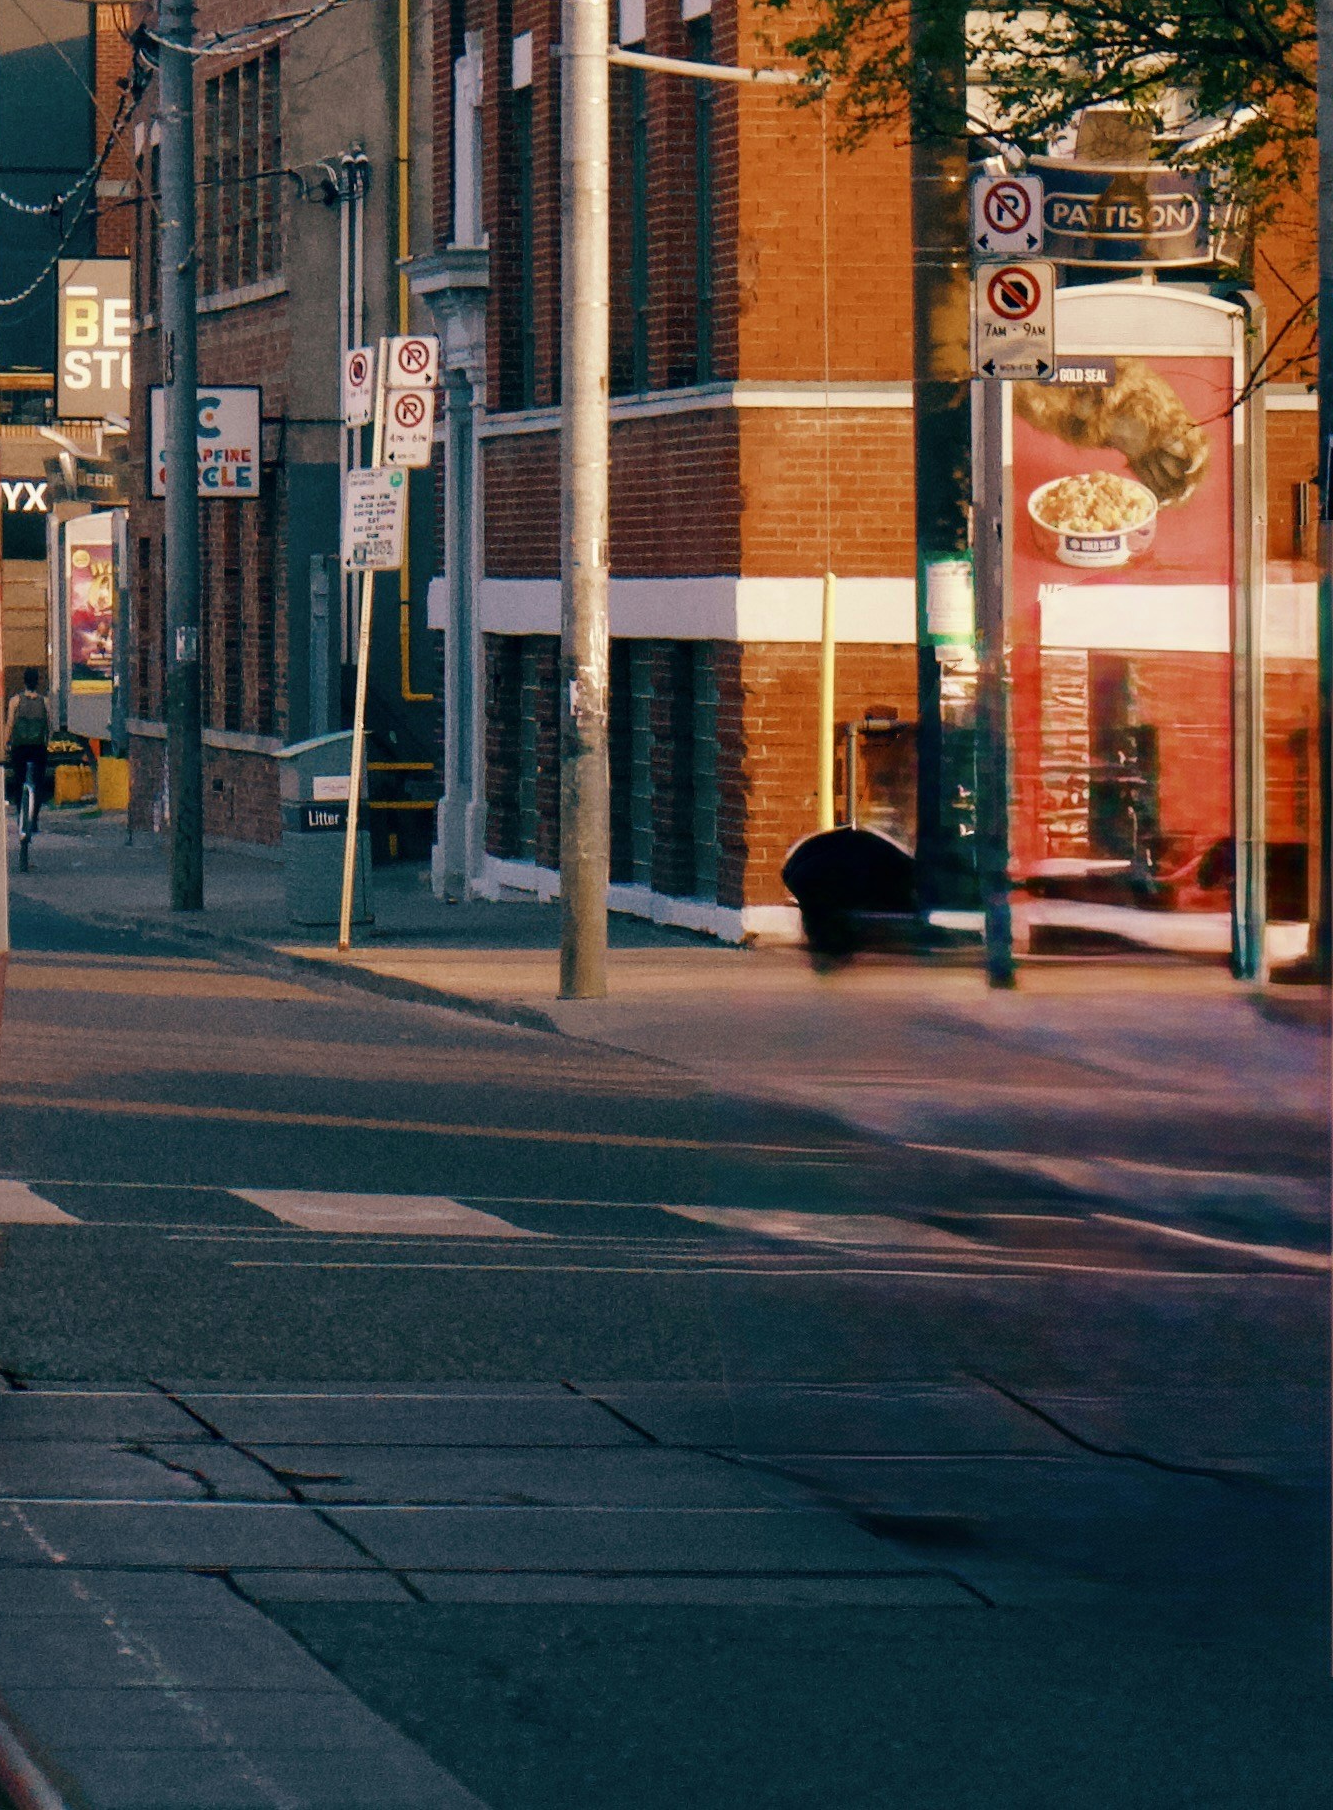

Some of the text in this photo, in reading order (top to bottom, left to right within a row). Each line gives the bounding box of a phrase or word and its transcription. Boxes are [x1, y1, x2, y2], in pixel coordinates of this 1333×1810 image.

[1053, 202, 1188, 229] PATTISON
[64, 350, 131, 390] ST
[1059, 368, 1108, 383] GOLD SEAL
[307, 810, 341, 828] Litter
